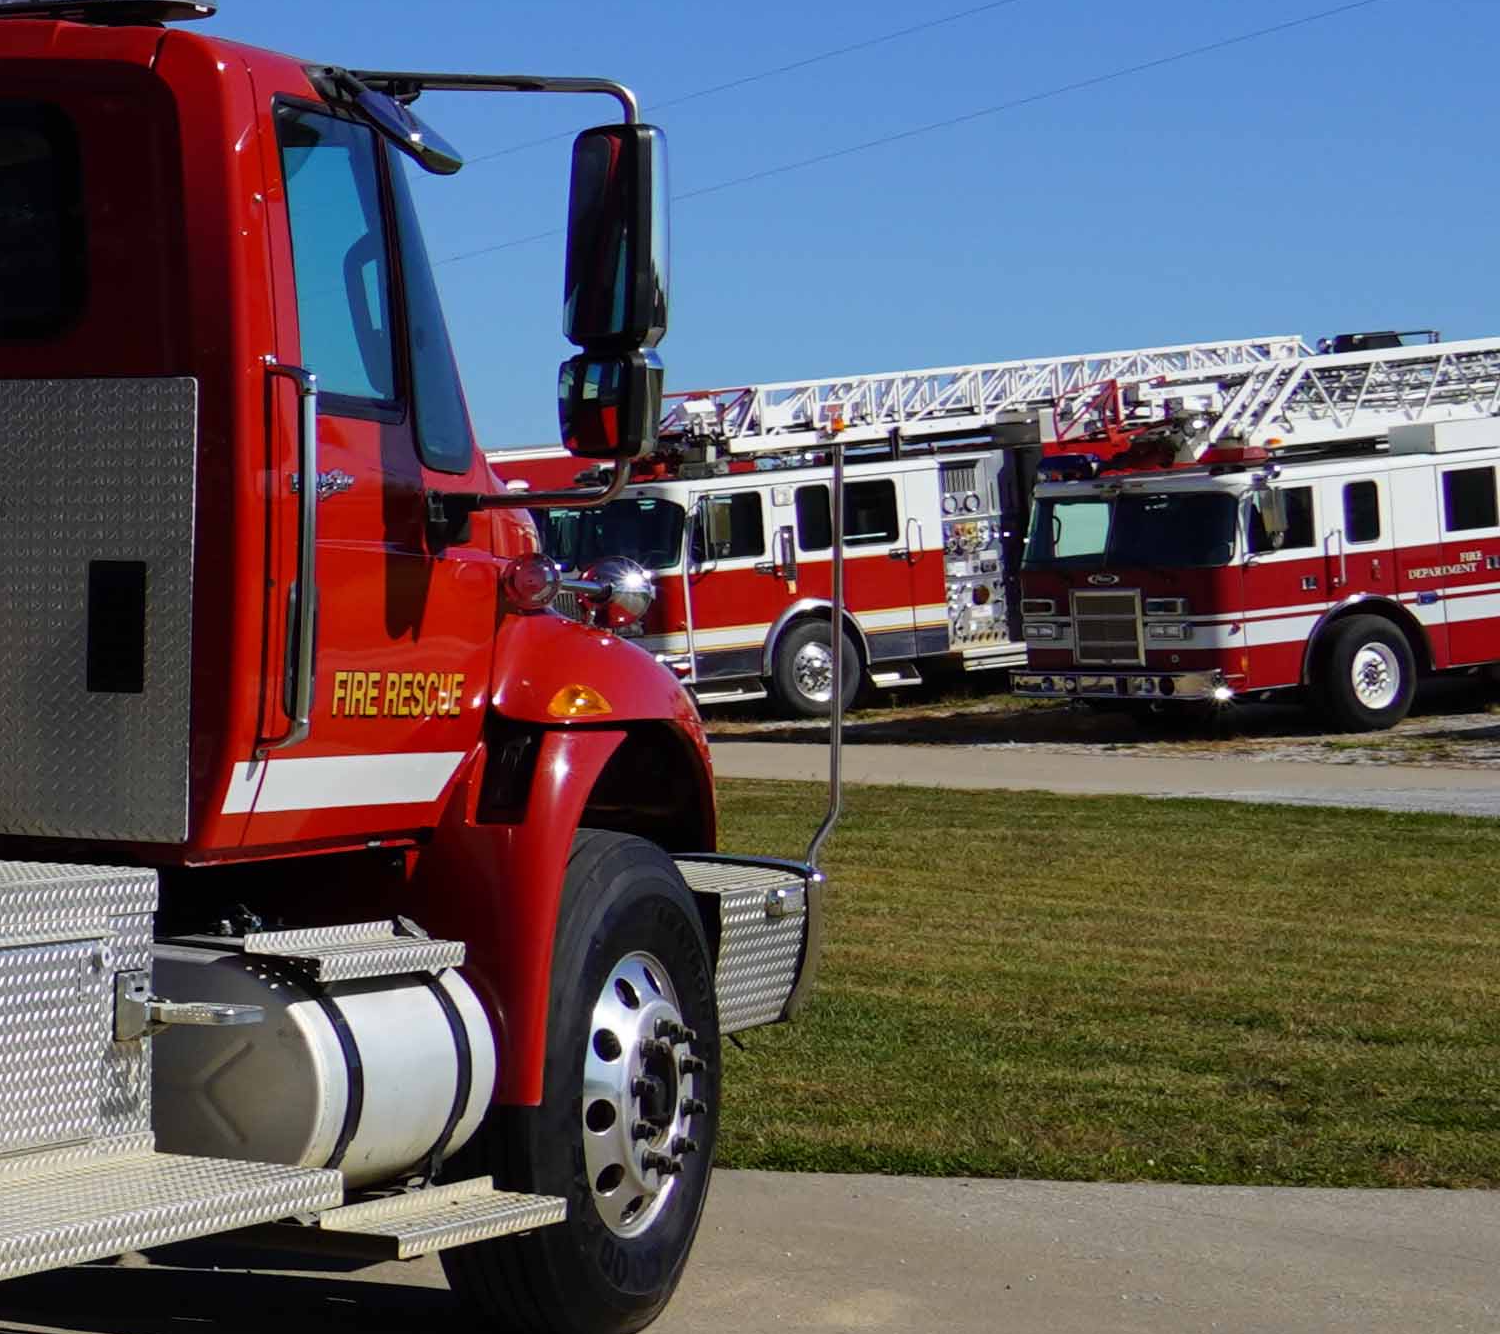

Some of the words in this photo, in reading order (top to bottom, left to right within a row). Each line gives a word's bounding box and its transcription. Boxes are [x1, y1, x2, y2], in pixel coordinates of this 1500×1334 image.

[1459, 550, 1483, 563] FIRE
[1407, 563, 1478, 580] DEPARTMENT
[331, 671, 382, 716] FIRE
[382, 671, 466, 717] RESCUE
